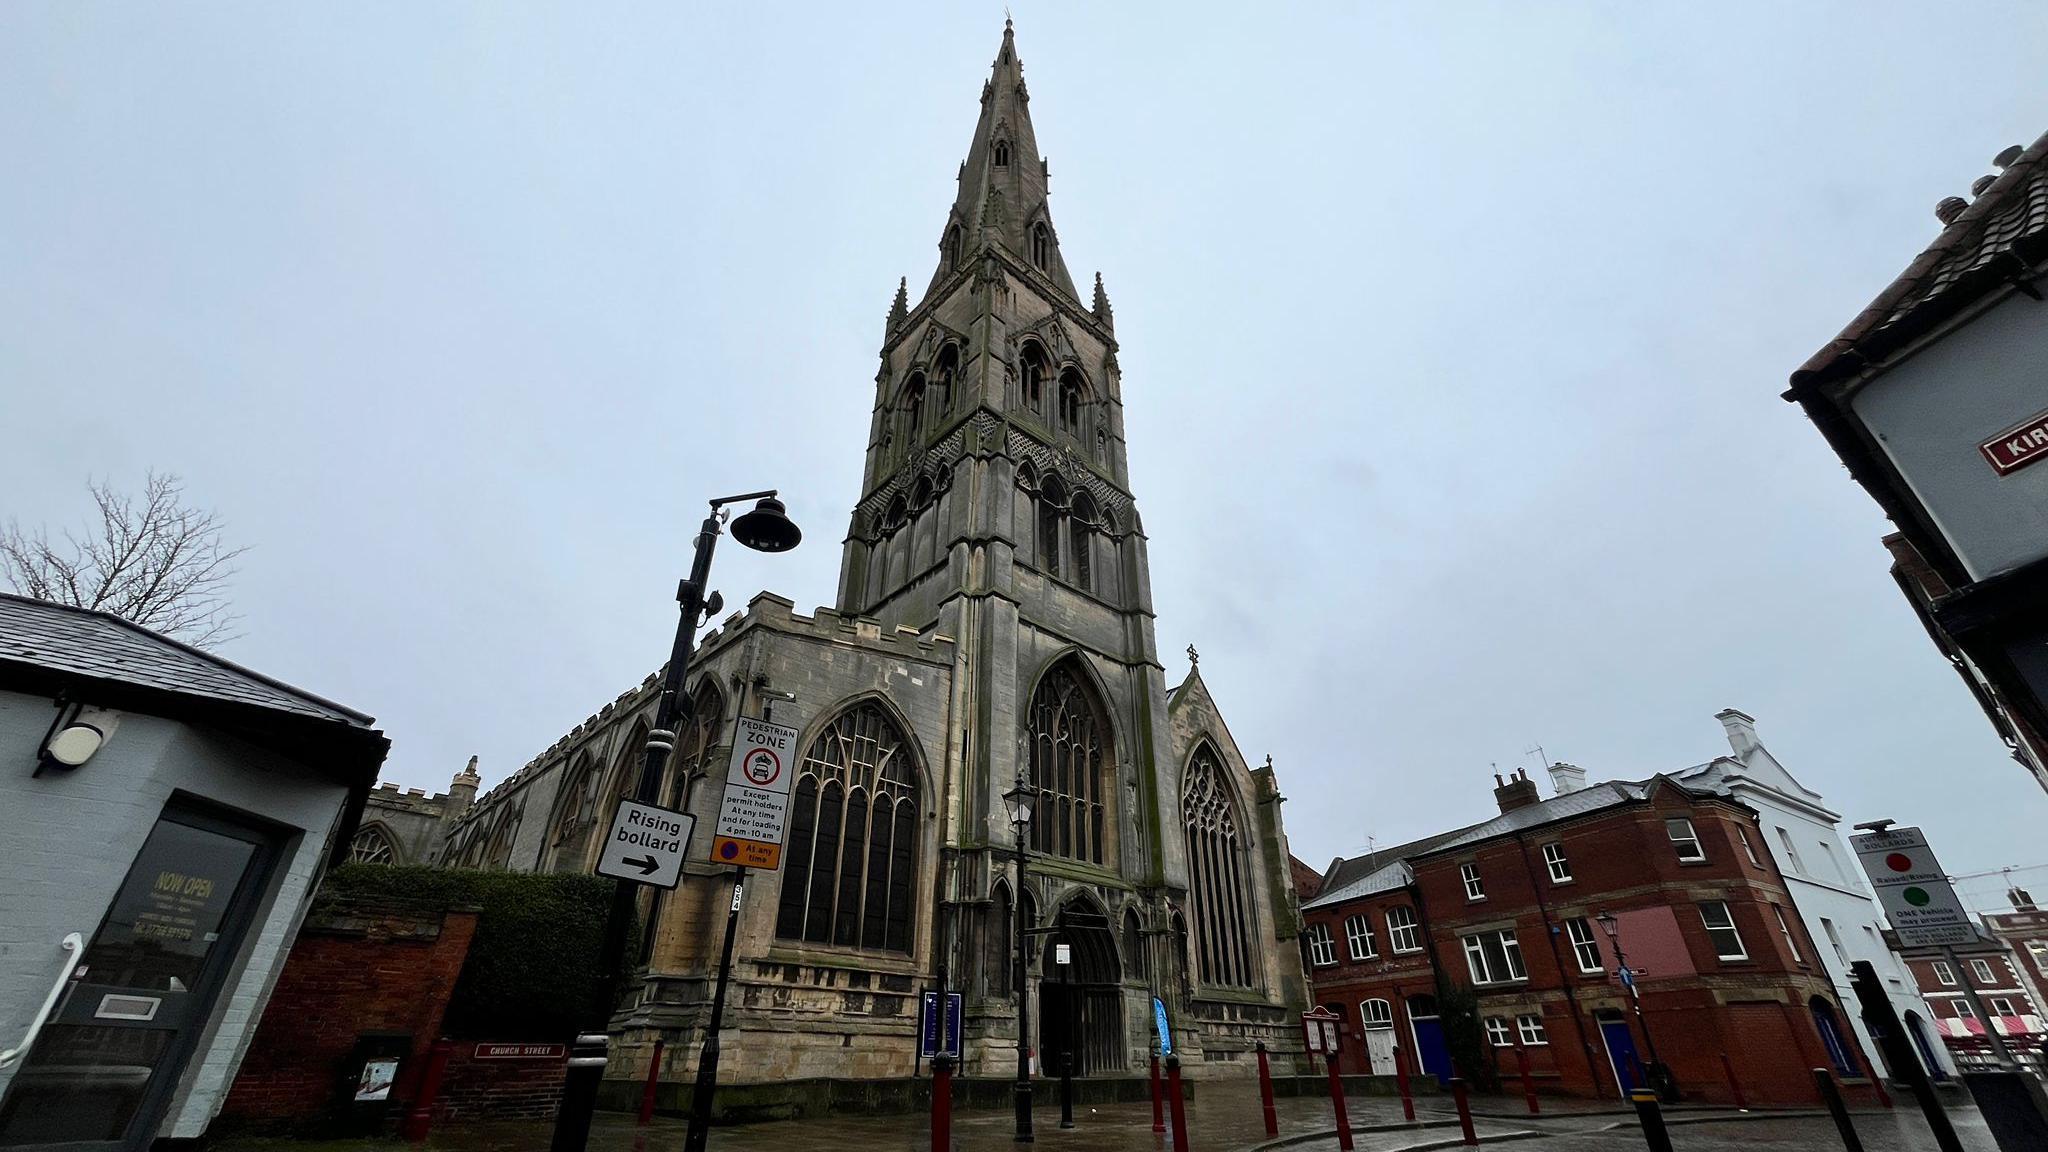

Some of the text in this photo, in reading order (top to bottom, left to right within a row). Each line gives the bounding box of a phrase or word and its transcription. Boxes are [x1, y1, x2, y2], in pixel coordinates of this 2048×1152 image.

[2006, 423, 2048, 456] KIR
[741, 720, 795, 738] PEDESTRIAN
[747, 731, 786, 749] ZONE
[743, 789, 770, 800] Except
[727, 796, 783, 811] permit holders
[731, 806, 775, 820] At any time
[628, 809, 680, 837] Rising
[722, 816, 781, 832] and for loading
[617, 826, 680, 853] bollard
[752, 829, 761, 837] 10
[746, 845, 773, 856] At any
[1864, 840, 1914, 850] BOLLARDS
[749, 854, 767, 863] time
[154, 872, 216, 898] NOW OPEN
[490, 1046, 552, 1055] CHURCH STREET
